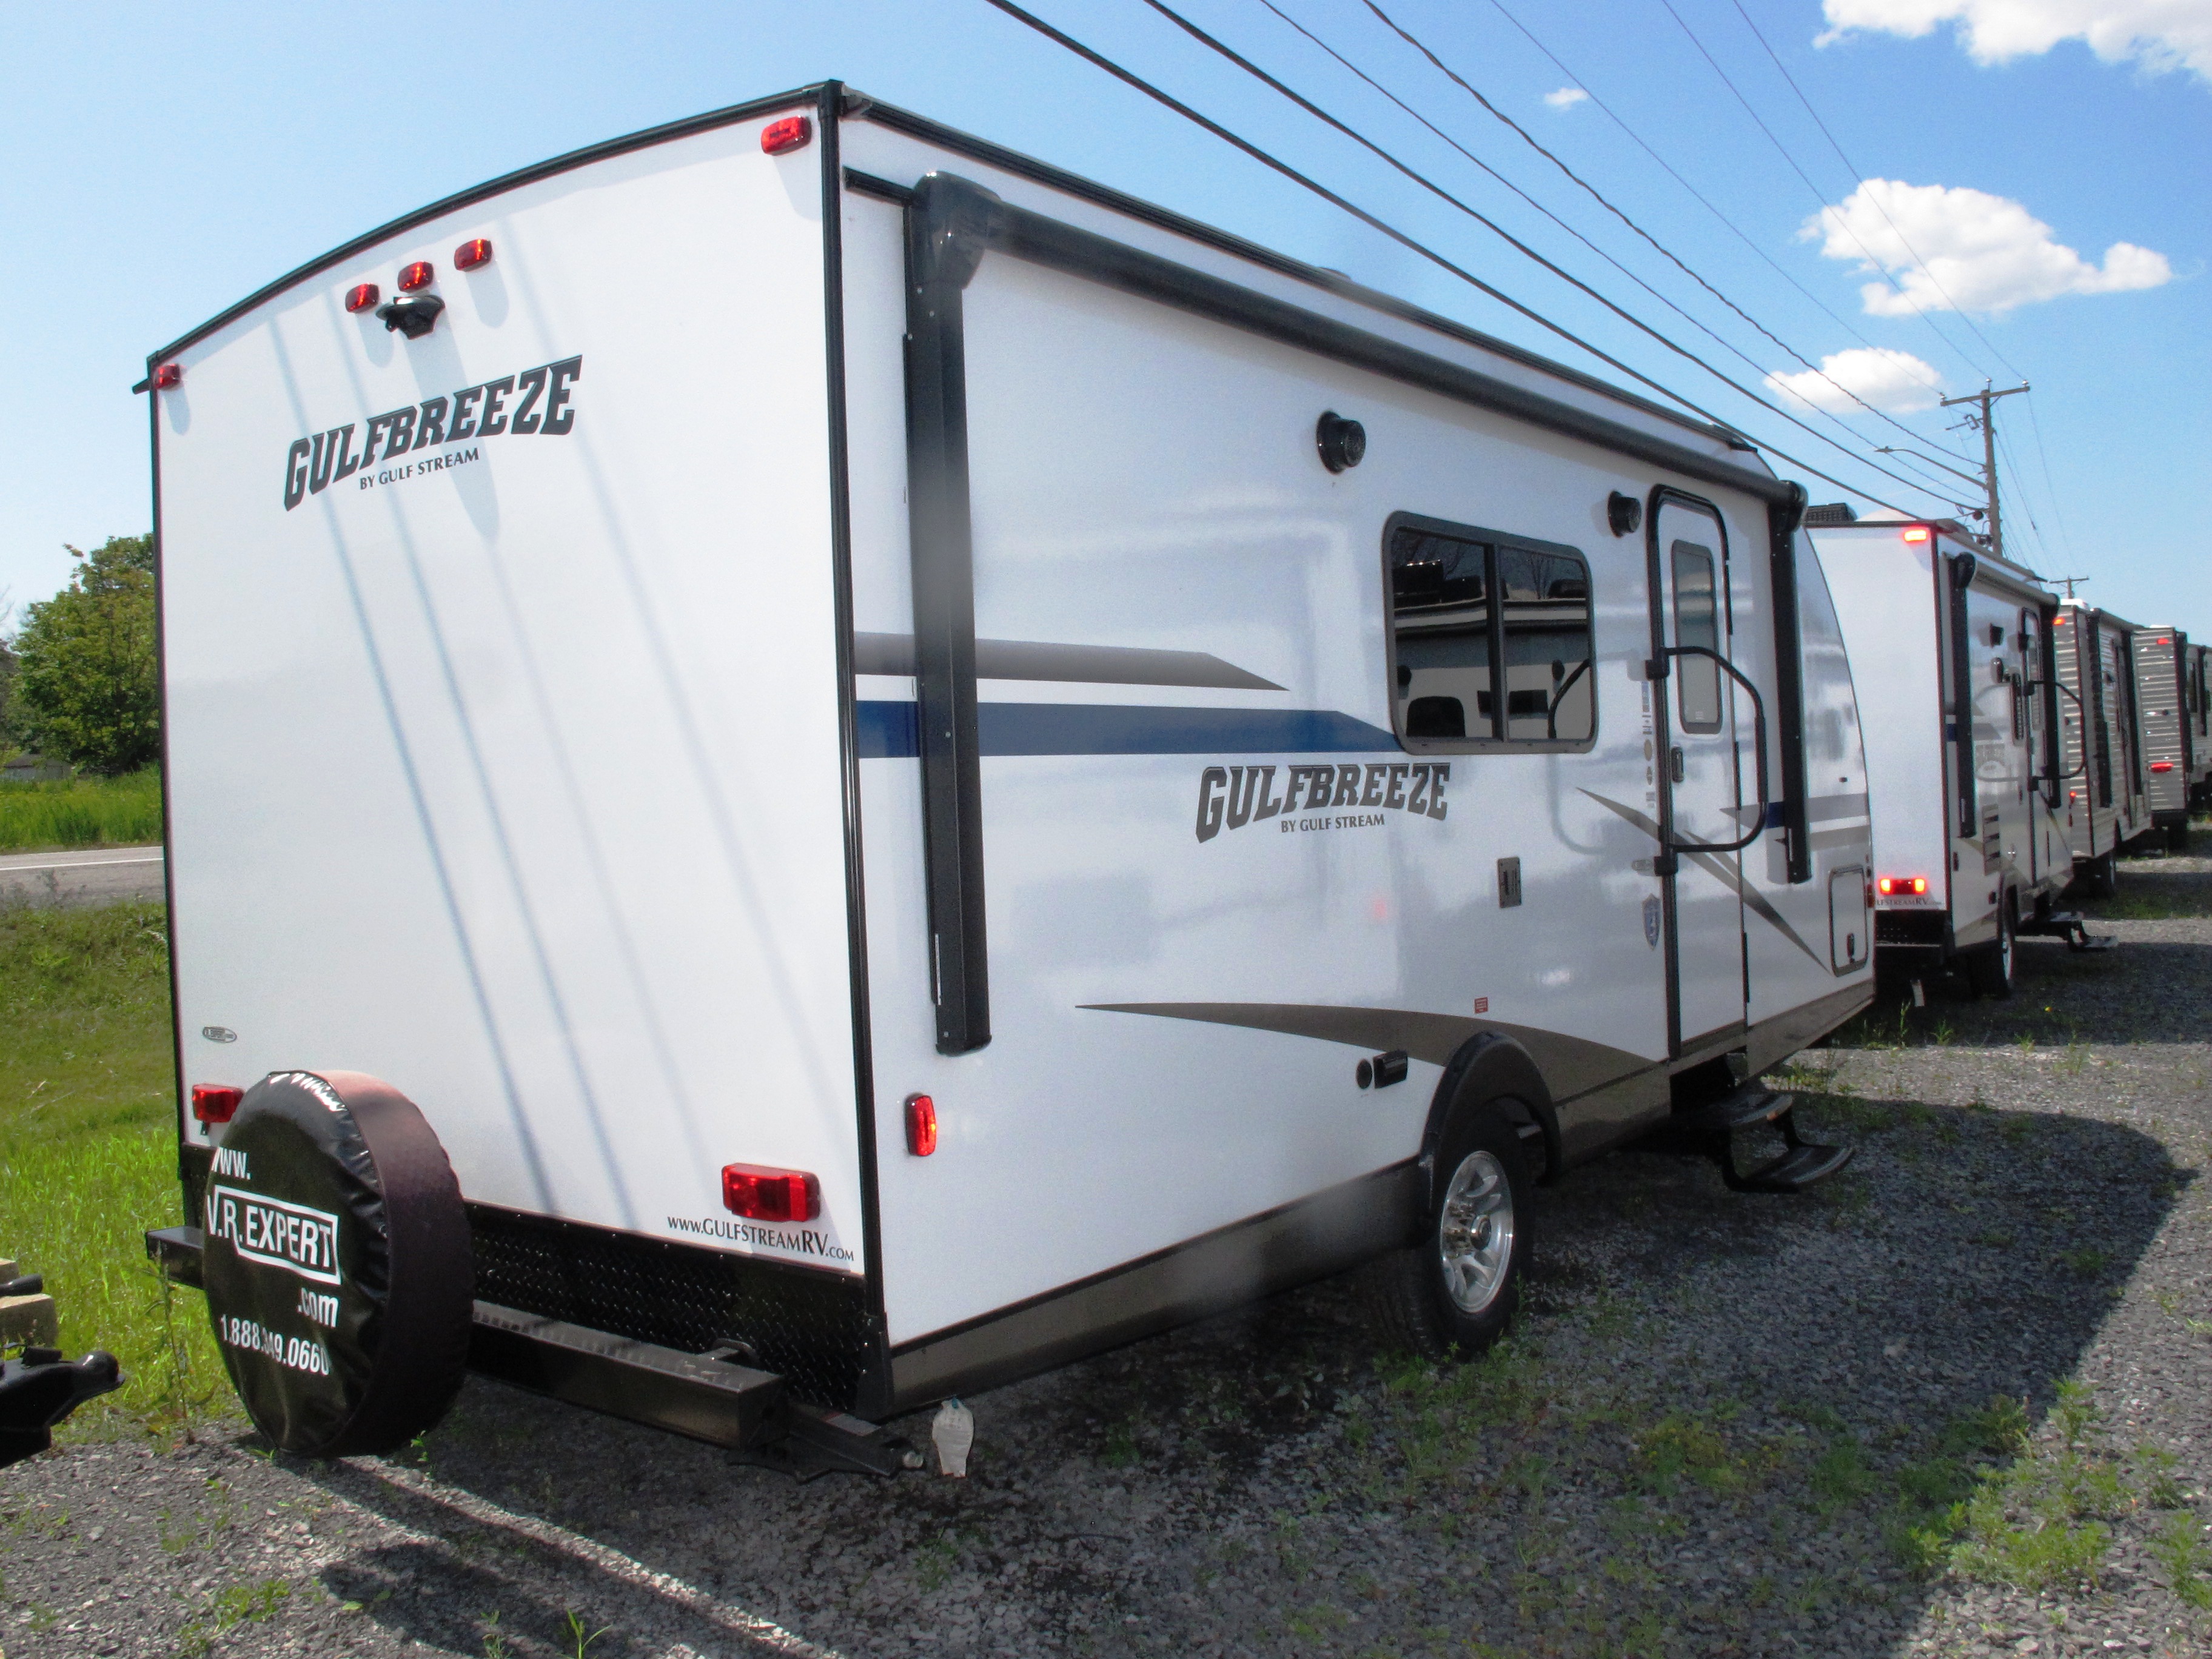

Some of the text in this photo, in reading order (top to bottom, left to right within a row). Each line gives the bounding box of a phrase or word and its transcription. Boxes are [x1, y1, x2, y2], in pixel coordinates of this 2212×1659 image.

[284, 355, 583, 512] GULFBREEZE
[360, 447, 480, 490] BY GULF STREAM
[1196, 762, 1451, 843] GULFBREEZE
[1281, 813, 1385, 833] BY GULF STREAM
